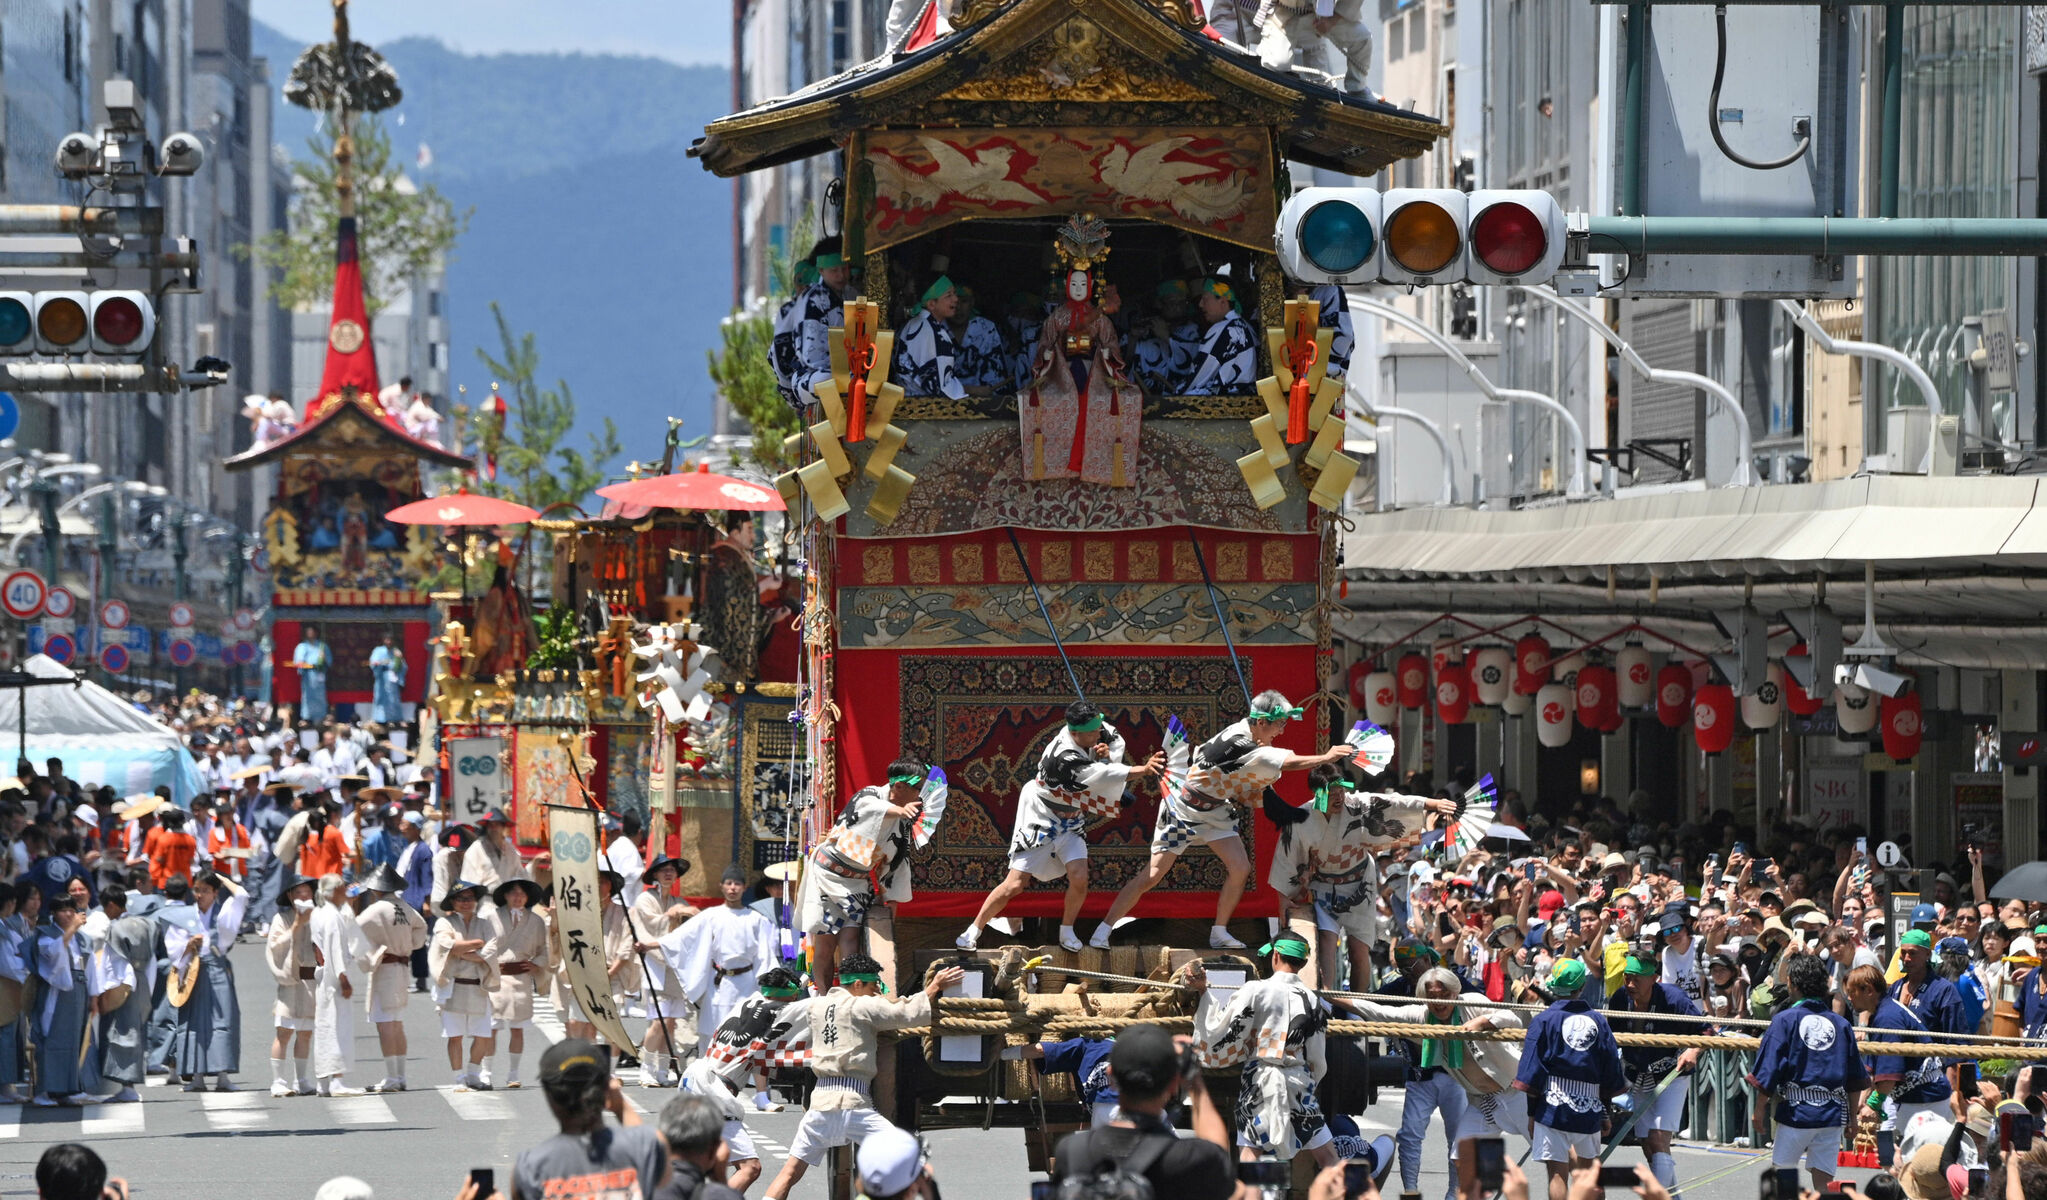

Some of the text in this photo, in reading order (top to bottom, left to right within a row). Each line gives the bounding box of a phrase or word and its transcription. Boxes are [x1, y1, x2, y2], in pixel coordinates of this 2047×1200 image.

[12, 584, 36, 605] 40
[466, 786, 487, 815] 占
[1814, 779, 1856, 799] SBC
[560, 875, 608, 1022] 伯牙山
[822, 1003, 839, 1049] 月鉾
